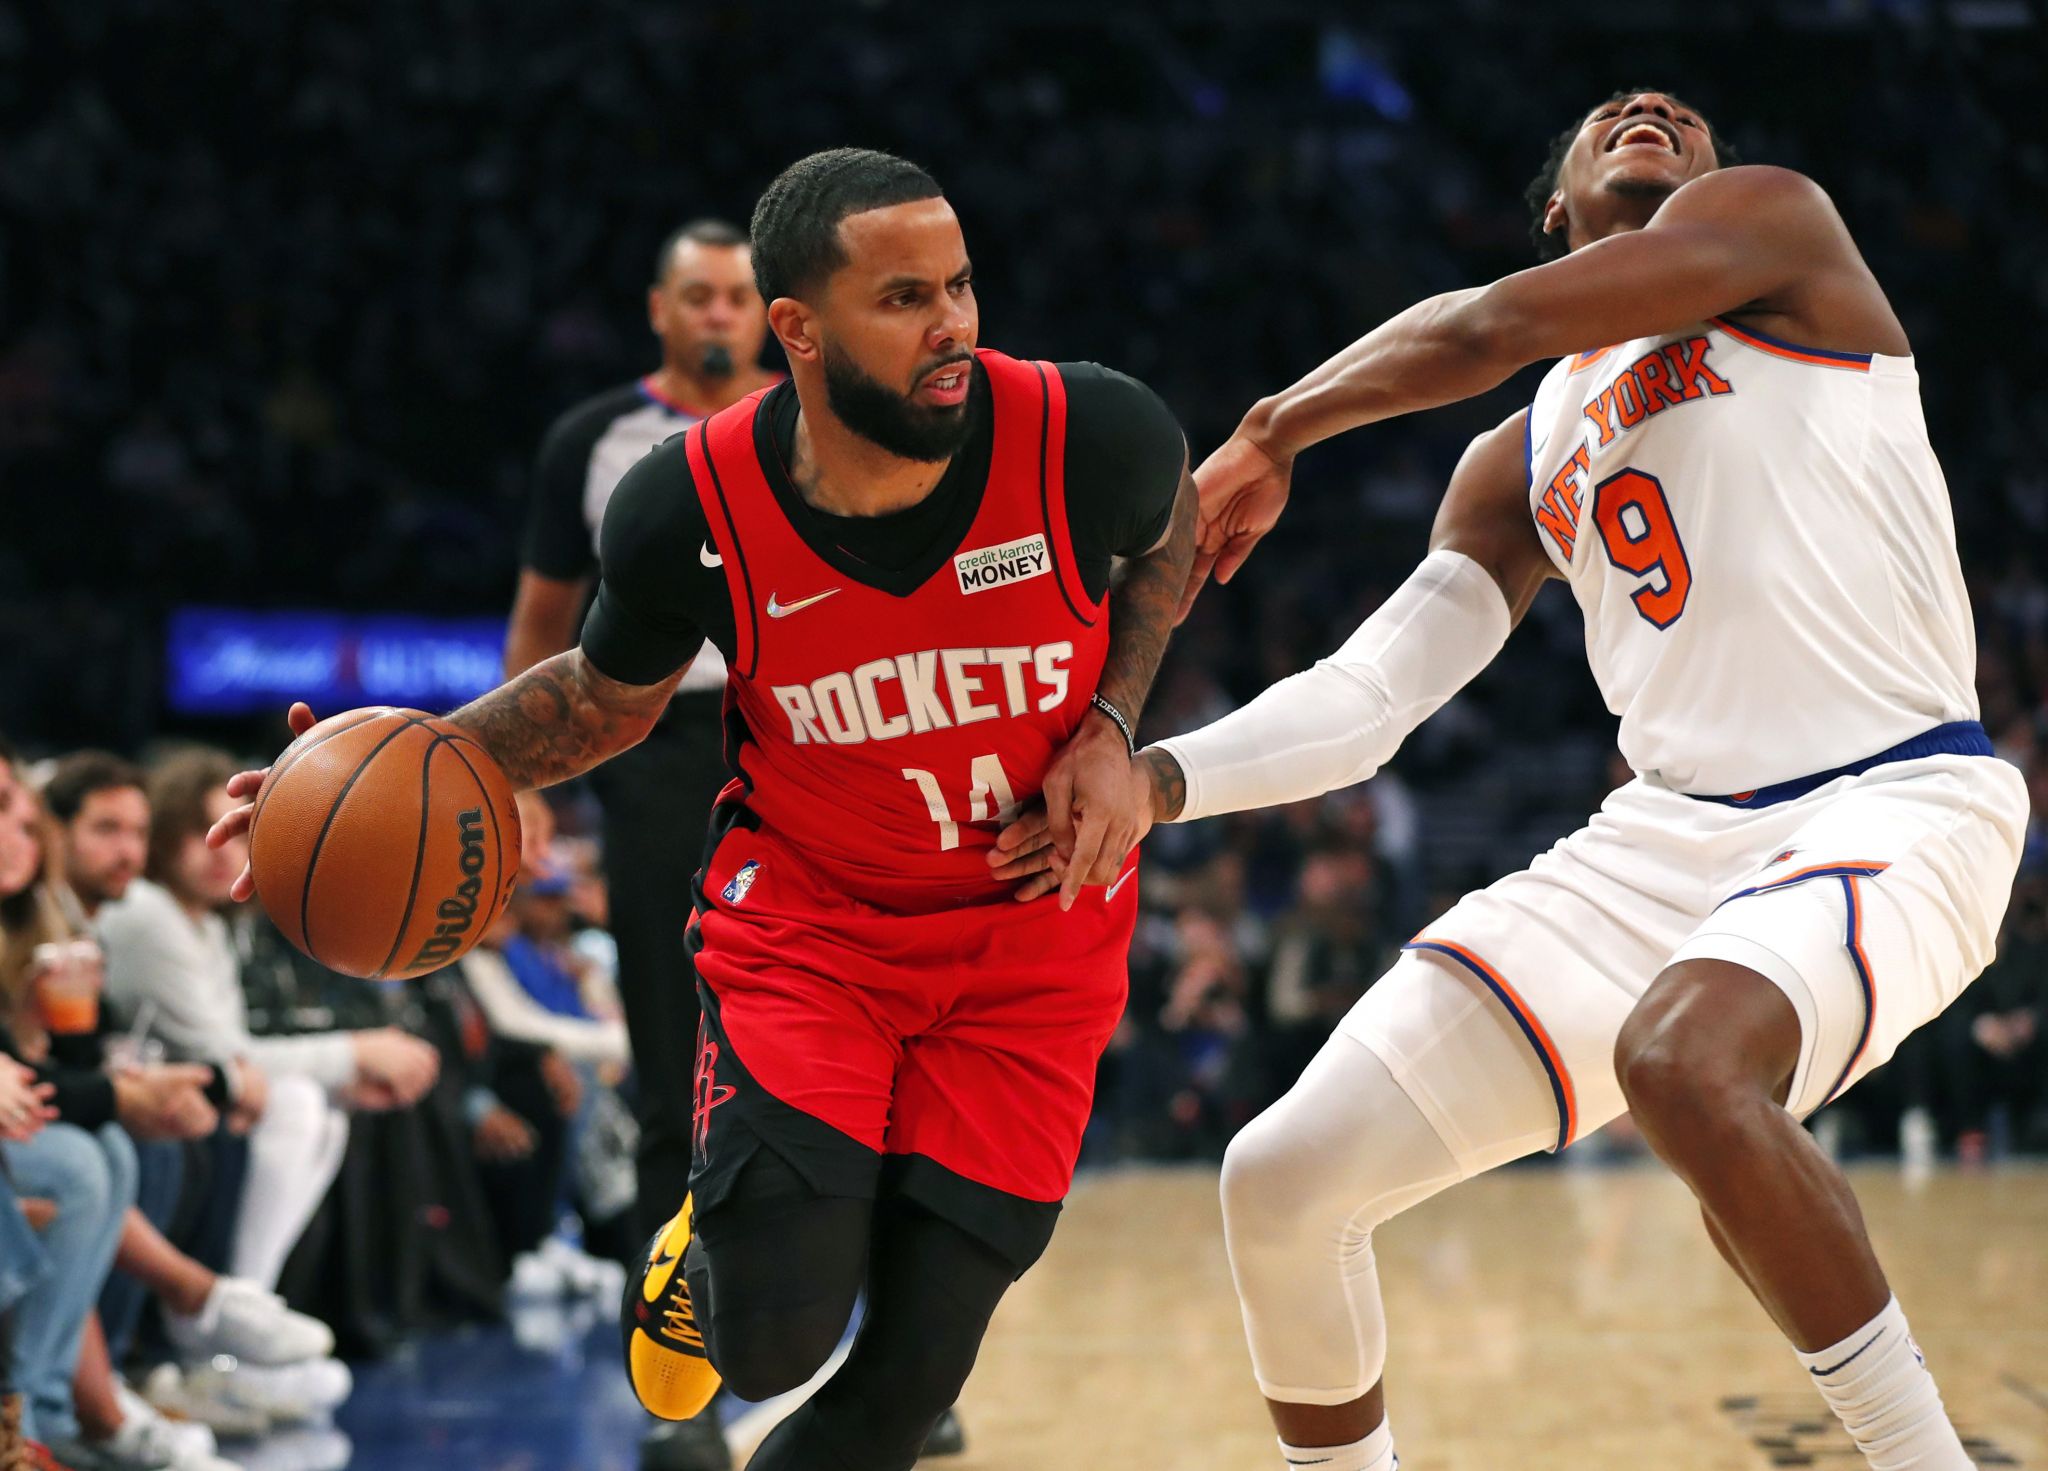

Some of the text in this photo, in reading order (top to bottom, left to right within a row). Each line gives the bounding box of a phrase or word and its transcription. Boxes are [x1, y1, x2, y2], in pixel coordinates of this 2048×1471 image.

[1583, 336, 1735, 448] YORK
[958, 540, 1044, 571] credit karma
[960, 551, 1044, 590] MONEY
[1591, 466, 1692, 631] 9
[771, 640, 1074, 745] ROCKETS
[901, 753, 1022, 851] 14
[402, 805, 485, 971] Wilson
